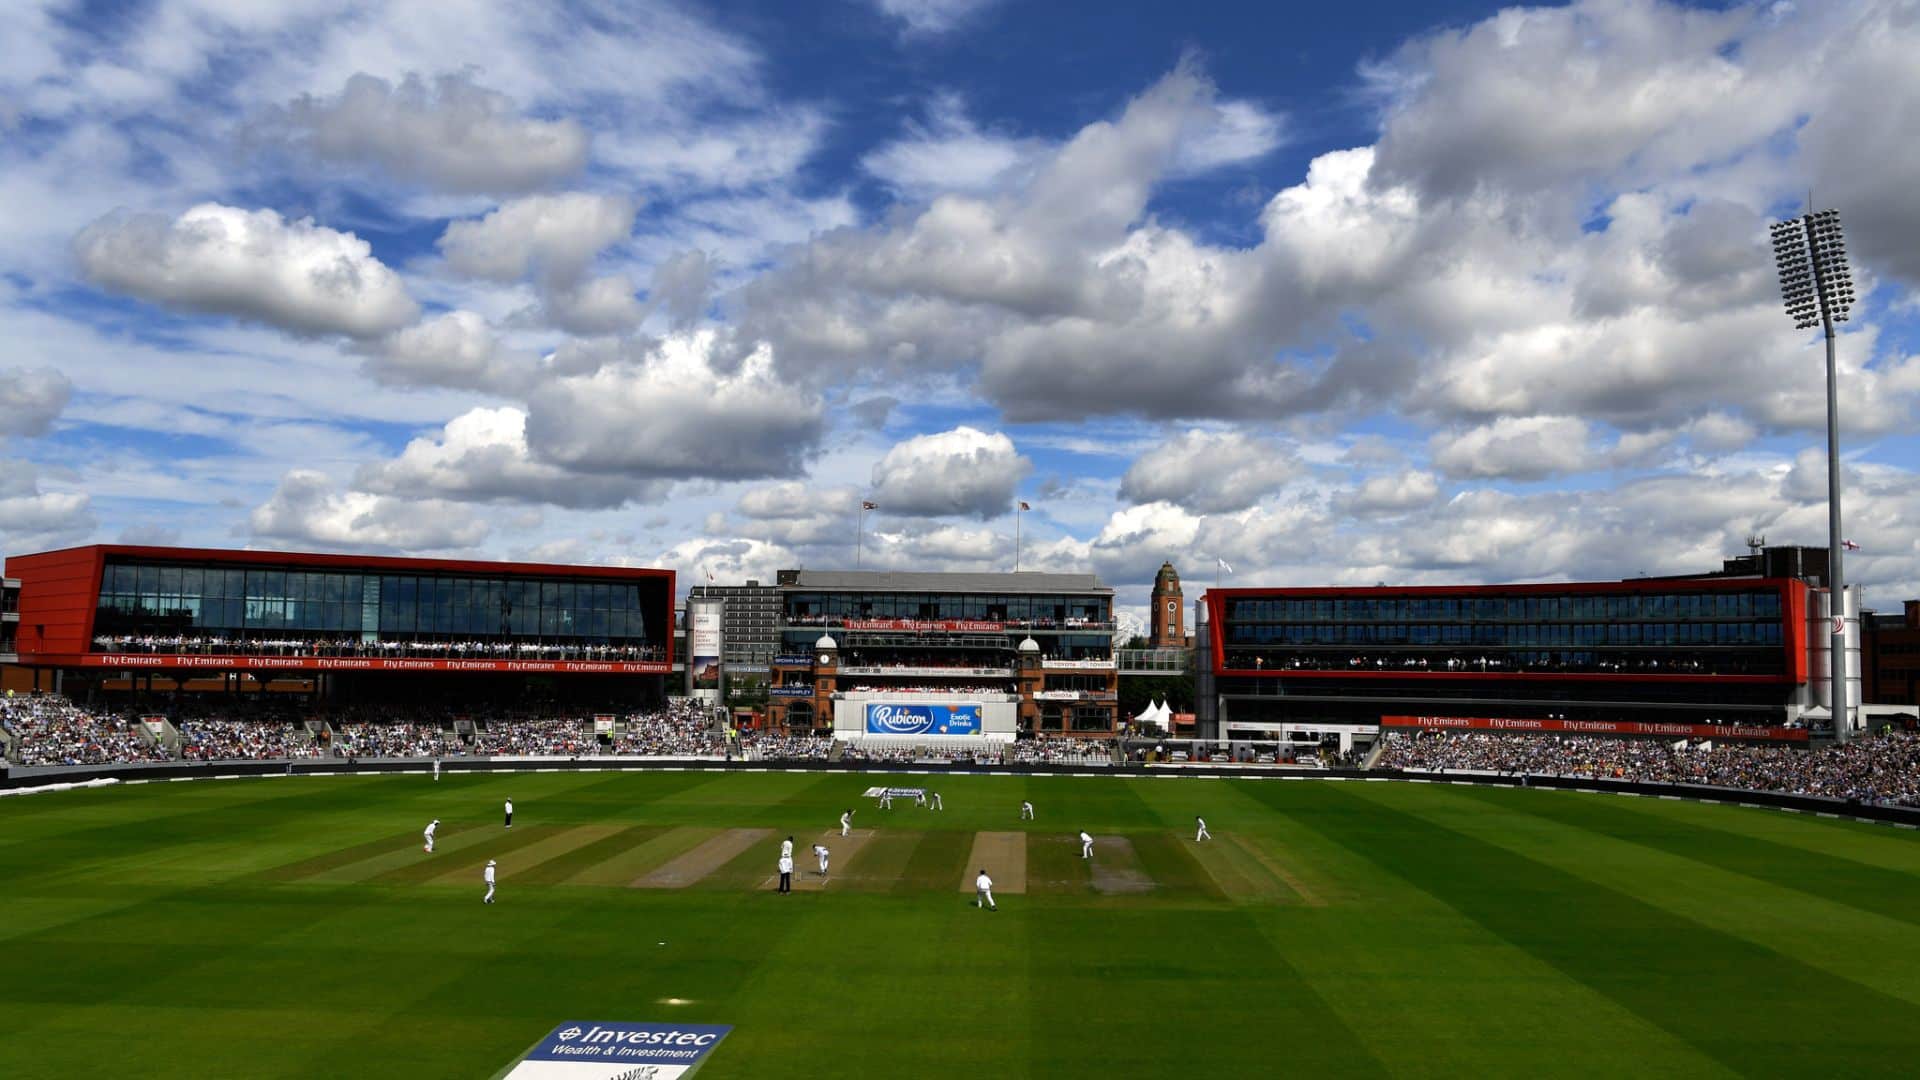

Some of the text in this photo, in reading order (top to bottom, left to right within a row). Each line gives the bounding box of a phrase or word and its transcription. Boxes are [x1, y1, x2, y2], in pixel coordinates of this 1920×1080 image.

[850, 619, 861, 629] Fly
[903, 620, 914, 629] Fly
[956, 620, 968, 630] Fly
[103, 656, 162, 665] Fly Emirates
[177, 657, 234, 666] Fly Emirates
[249, 658, 303, 667] Fly Emirates
[318, 659, 332, 668] Fly
[384, 660, 434, 669] Fly Emirates
[447, 661, 496, 670] Fly Emirates
[508, 662, 555, 671] Fly Emirates
[567, 663, 612, 671] Fly Emirates
[623, 664, 667, 672] Fly Emirates
[876, 706, 929, 726] Rubicon
[1418, 716, 1469, 726] Fly Emirates
[1489, 719, 1542, 729] Fly Emirates
[1564, 720, 1616, 730] Fly Emirates
[1639, 723, 1693, 733] Fly Emirates
[1715, 725, 1770, 736] Fly Emirates
[580, 1026, 717, 1046] Investec
[552, 1044, 699, 1058] Wealth & Investment
